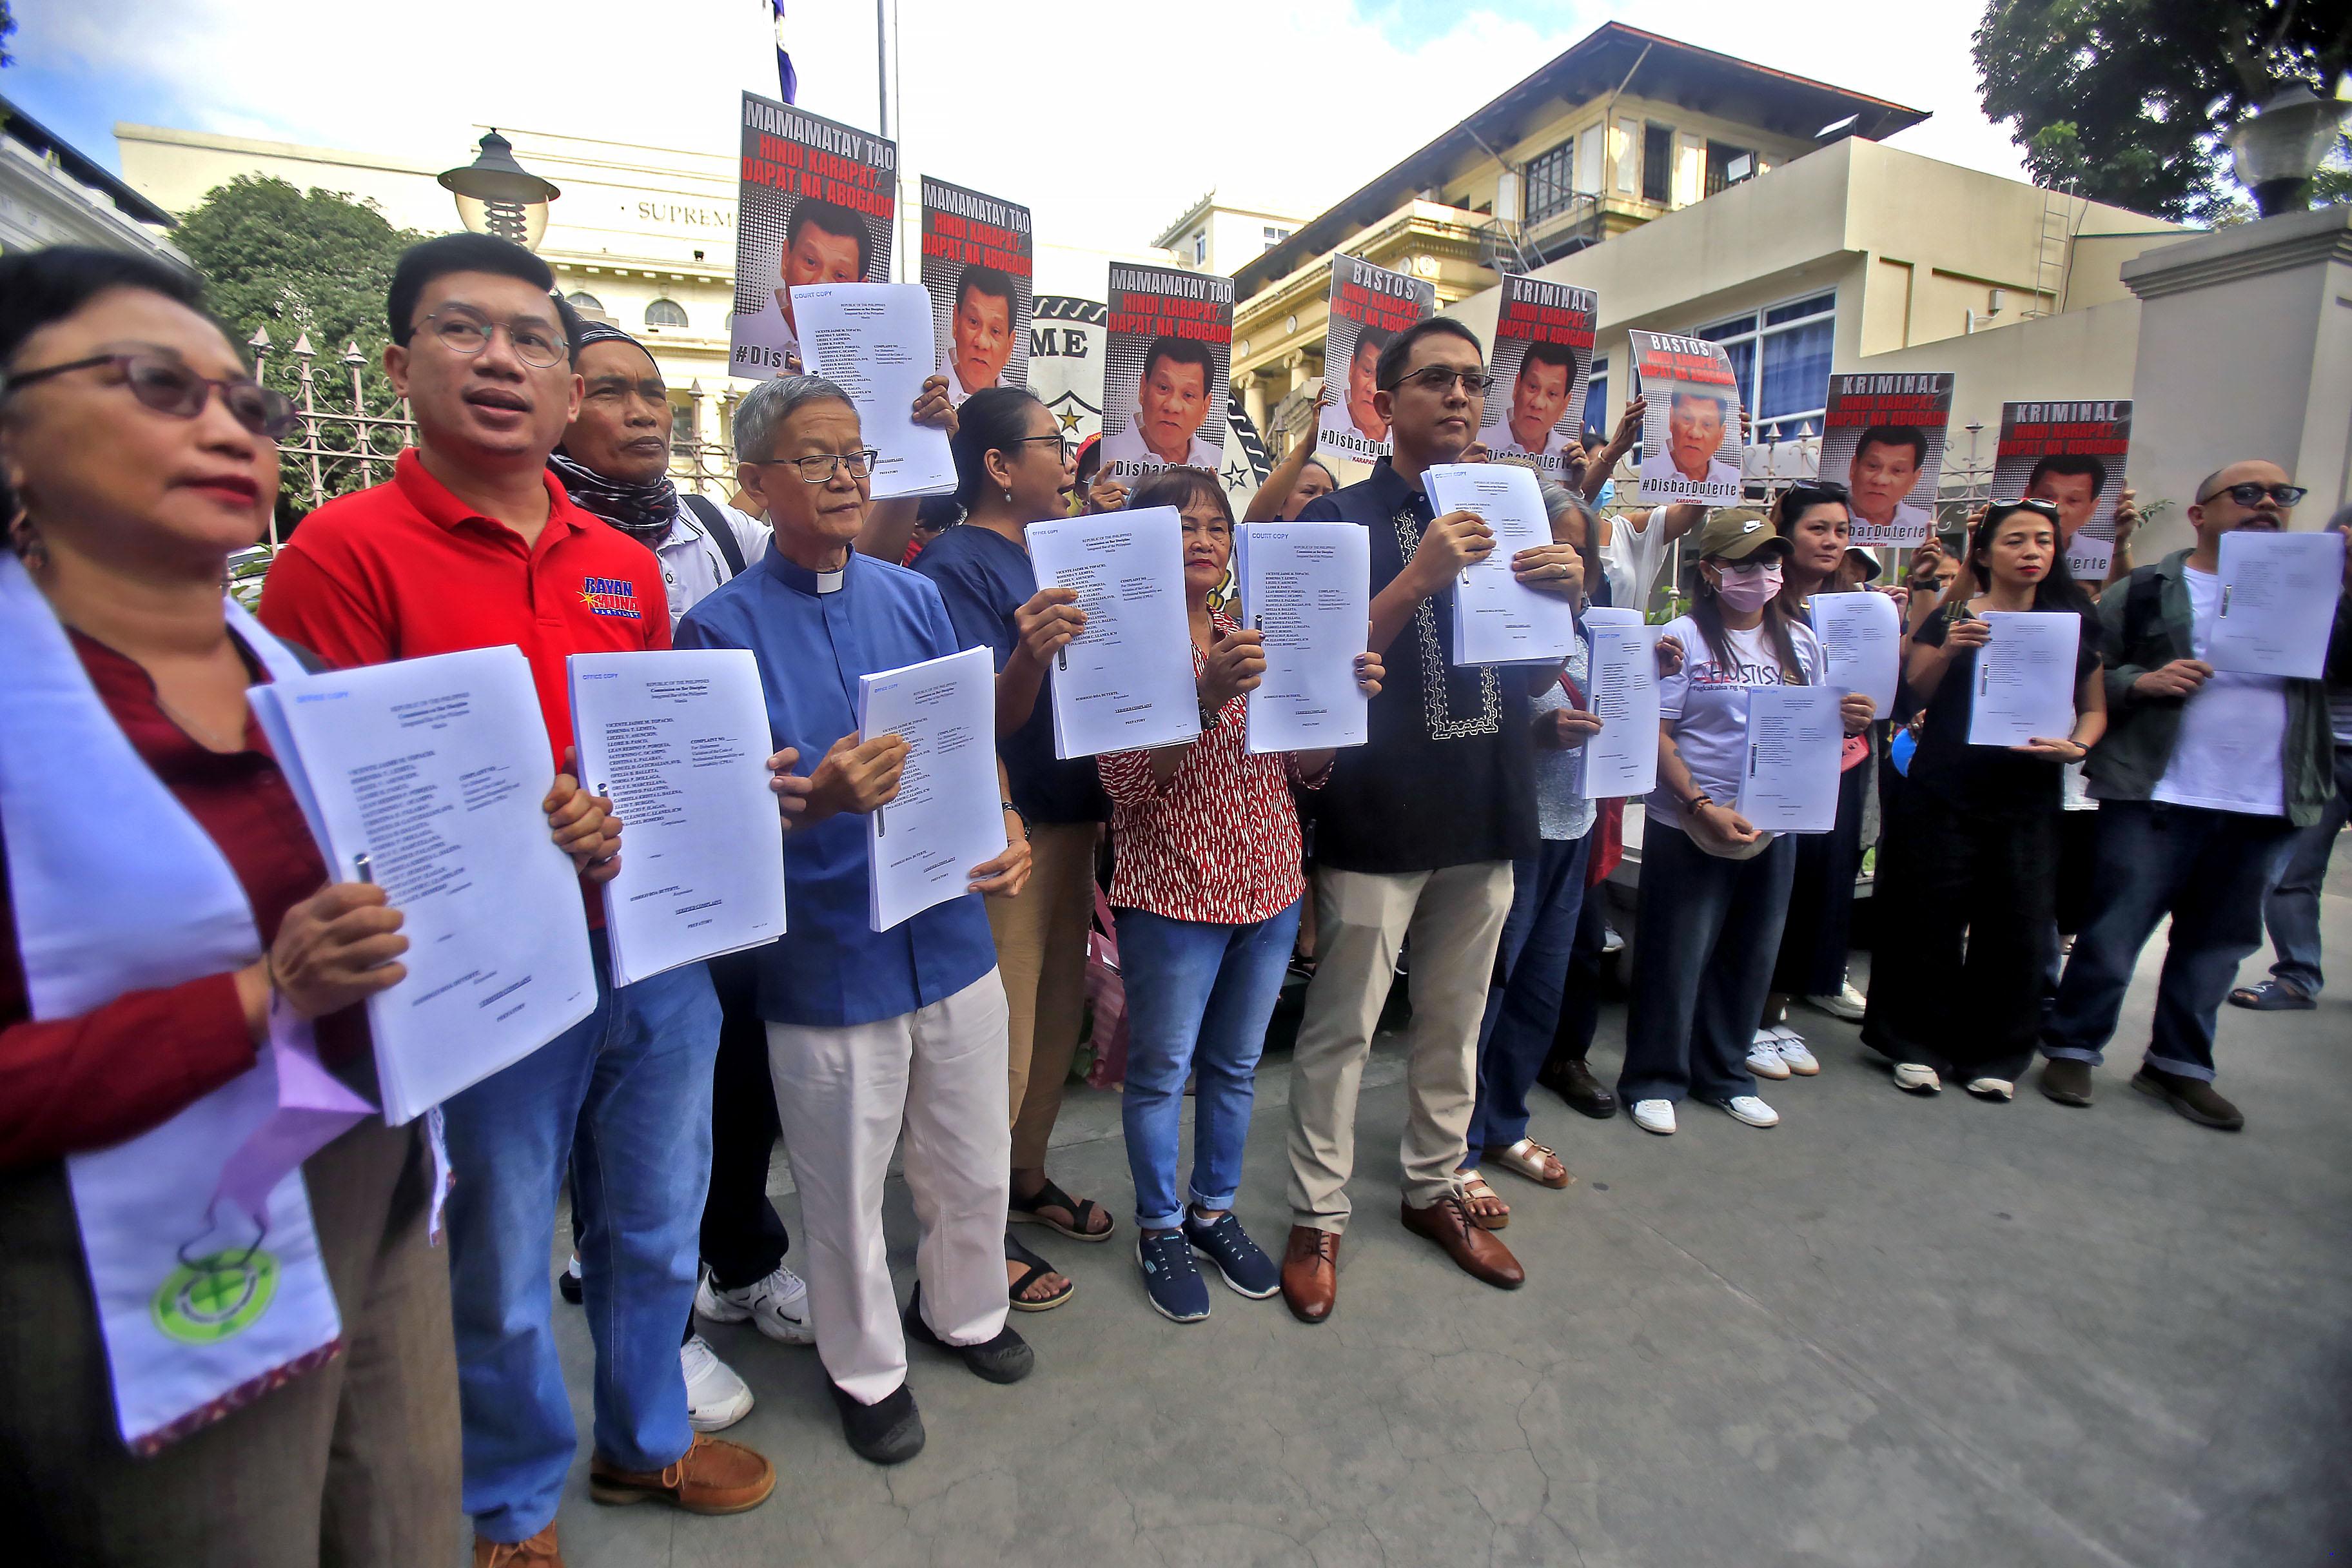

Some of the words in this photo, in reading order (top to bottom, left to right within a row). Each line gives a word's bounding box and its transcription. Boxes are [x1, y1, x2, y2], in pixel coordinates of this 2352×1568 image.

[745, 99, 862, 160] MAMAMATAY
[867, 140, 894, 170] TAO
[760, 134, 804, 169] HINDI
[808, 149, 881, 190] KARAPAT-
[742, 156, 796, 192] DAPAT
[801, 172, 822, 200] NA
[827, 181, 893, 219] ABOGADO
[638, 202, 738, 227] SUPREM
[924, 182, 1006, 226] MAMAMATAY
[1009, 208, 1030, 233] TAO
[935, 211, 966, 239] HINDI
[923, 233, 962, 261] DAPAT
[965, 243, 980, 266] NA
[984, 247, 1032, 277] ABOGADO
[1112, 269, 1206, 300] MAMAMATAY
[1210, 281, 1232, 303] TAO
[1342, 281, 1369, 305] HINDI
[1353, 263, 1415, 300] BASTOS
[1123, 293, 1159, 315] HINDI
[1513, 279, 1587, 311] KRIMINAL
[1331, 297, 1363, 320] DAPAT
[1366, 308, 1378, 327] NA
[1510, 302, 1538, 321] HINDI
[1108, 313, 1153, 335] DAPAT
[1157, 318, 1173, 337] NA
[1178, 320, 1231, 343] ABOGADO
[1498, 319, 1532, 338] DAPAT
[1533, 324, 1547, 342] NA
[1550, 326, 1594, 348] ABOGADO
[1651, 335, 1709, 356] BASTOS
[1843, 375, 1939, 394] KRIMINAL
[1840, 395, 1874, 409] HINDI
[2016, 403, 2118, 422] KRIMINAL
[1825, 411, 1867, 426] DAPAT
[1871, 411, 1887, 426] NA
[1890, 411, 1950, 426] ABOGADO
[1999, 440, 2042, 455] DAPAT
[2045, 440, 2063, 454] NA
[1643, 478, 1736, 496] #DisbarDuterte
[585, 577, 632, 596] BAYAN
[594, 594, 640, 612] MUNA
[594, 609, 639, 618] PARTYLIST
